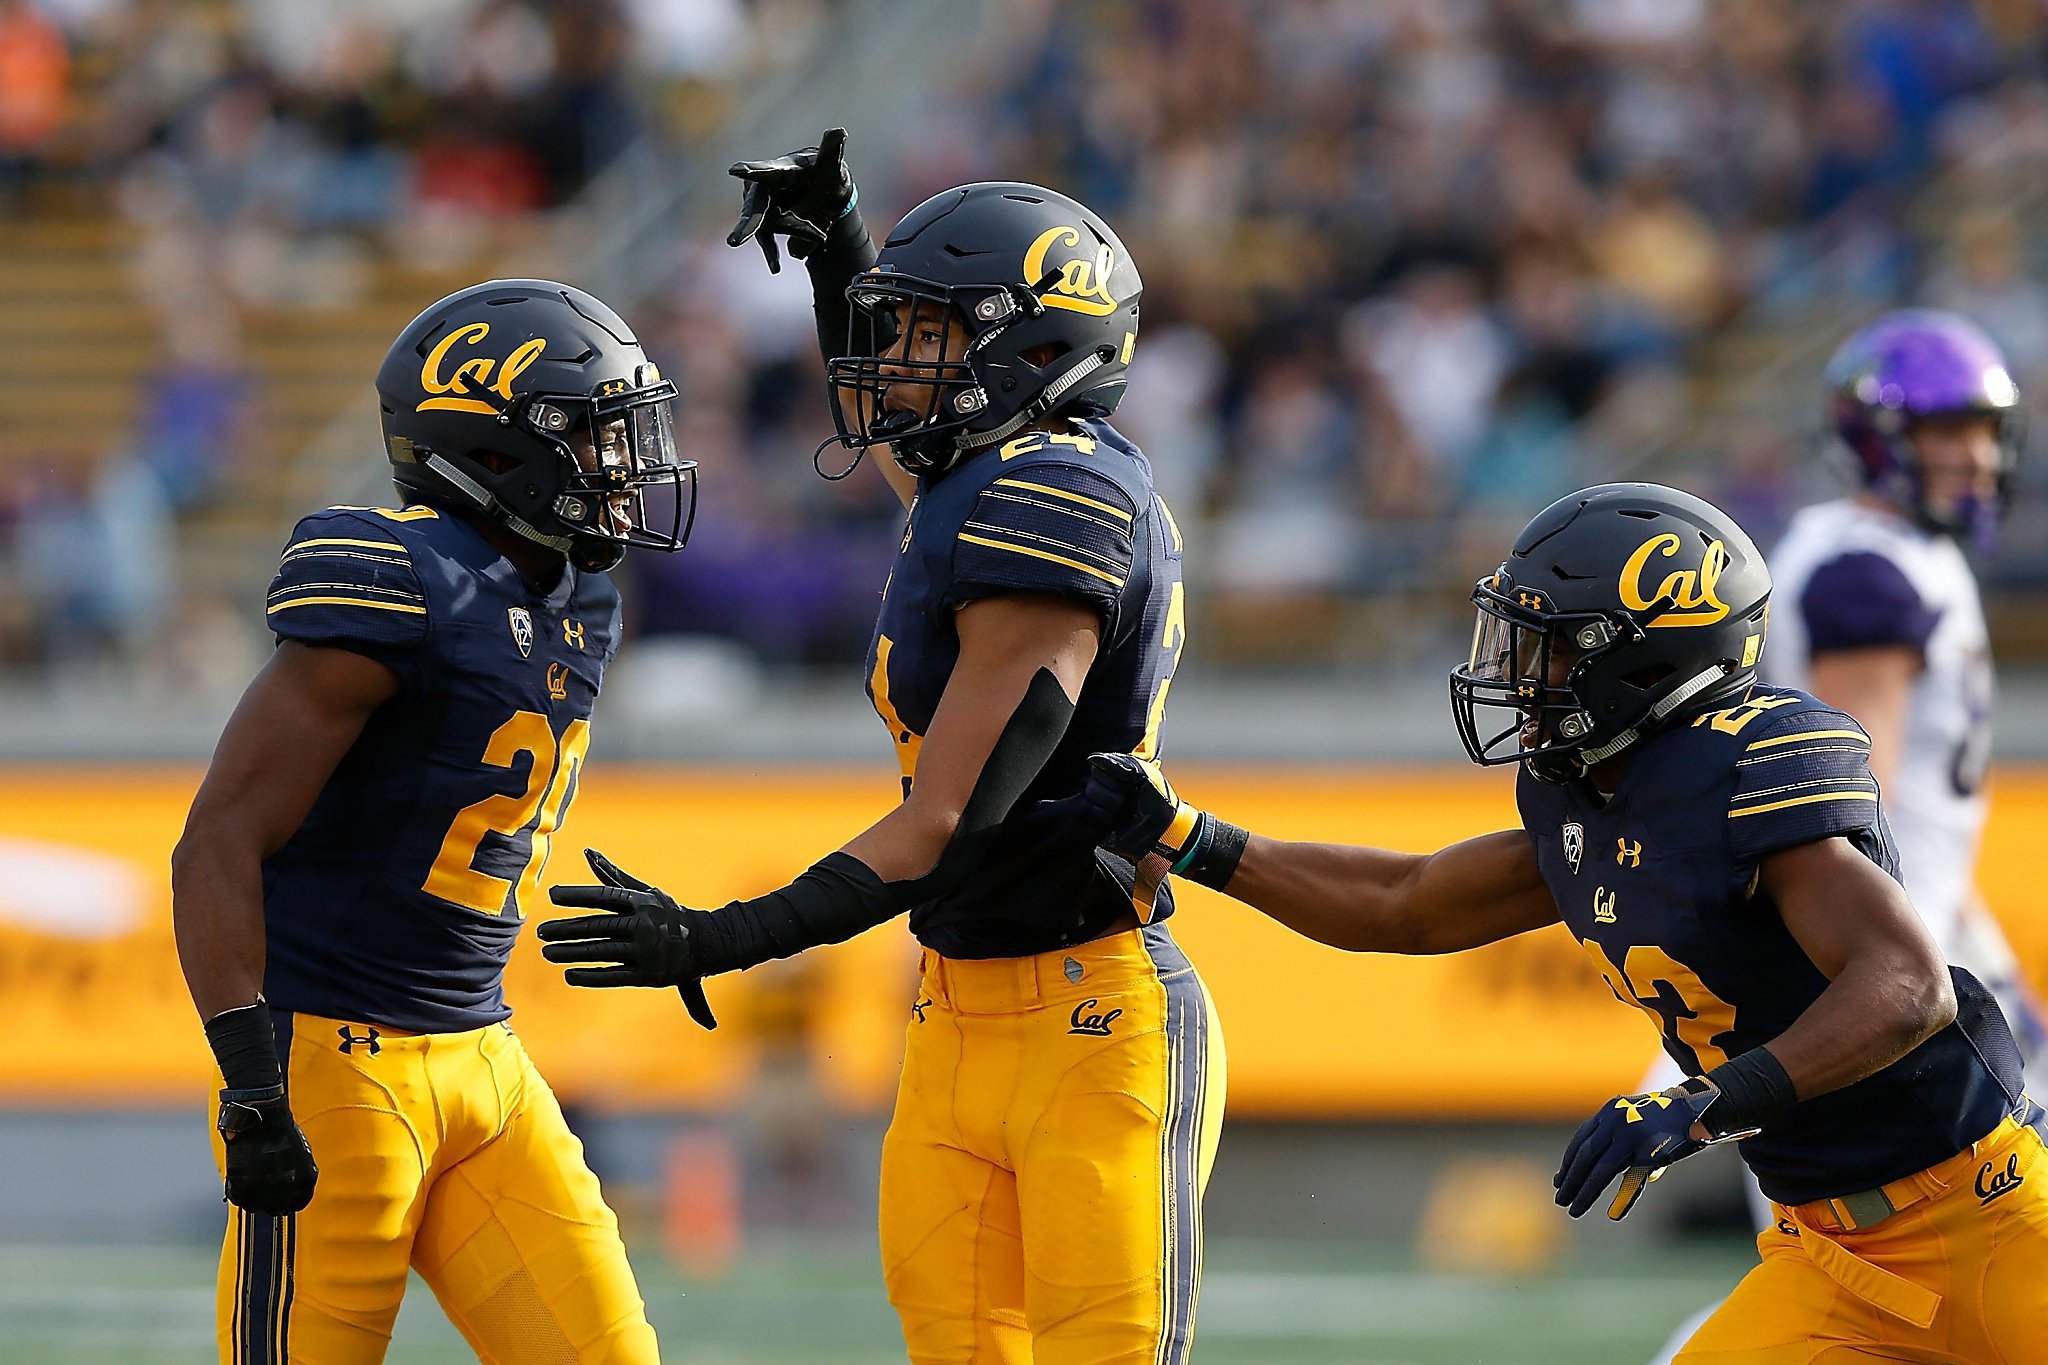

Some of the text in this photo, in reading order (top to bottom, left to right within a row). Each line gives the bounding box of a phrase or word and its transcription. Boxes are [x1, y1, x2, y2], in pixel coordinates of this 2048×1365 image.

[1023, 225, 1119, 317] Cal
[415, 322, 548, 415] Cal
[1618, 533, 1731, 628] Cal
[517, 627, 531, 647] 12
[546, 662, 569, 700] Cal
[421, 709, 592, 921] 20
[1567, 844, 1579, 863] 12
[1593, 886, 1618, 924] Cal
[1066, 998, 1123, 1037] Cal
[1973, 1152, 2025, 1207] Cal
